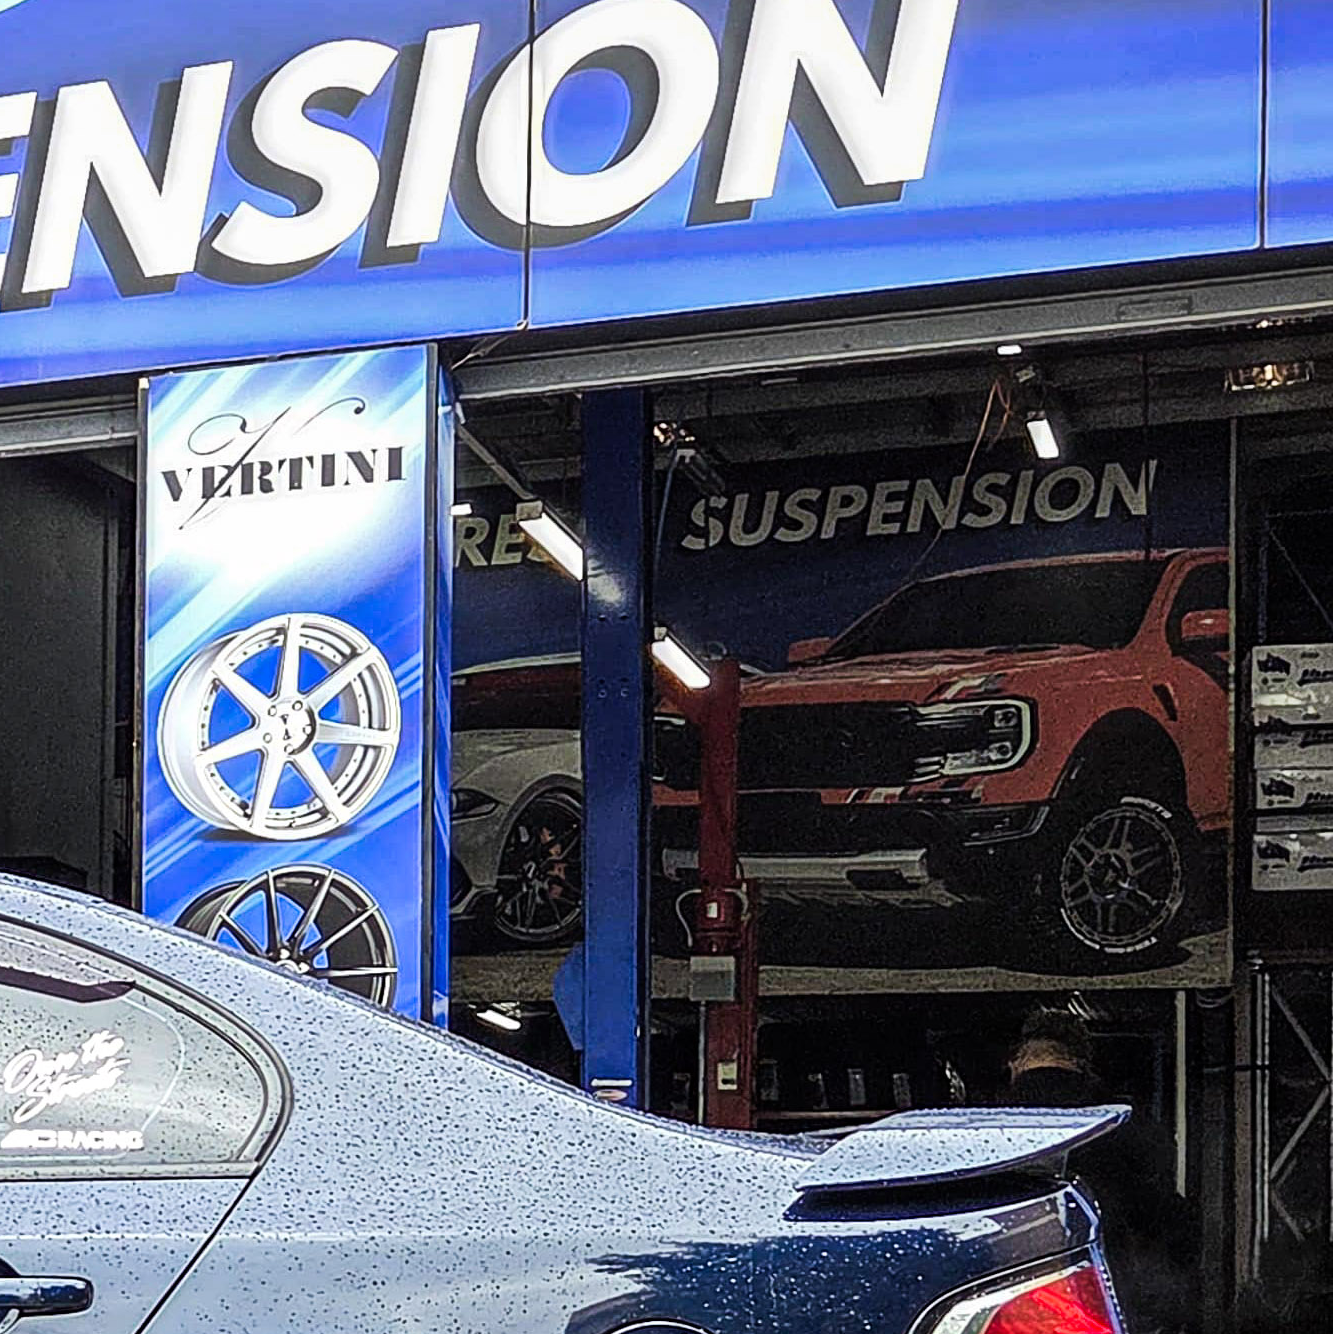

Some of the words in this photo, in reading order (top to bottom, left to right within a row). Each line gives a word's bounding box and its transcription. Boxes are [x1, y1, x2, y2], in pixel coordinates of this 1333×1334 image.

[161, 446, 408, 502] VERTINI
[680, 458, 1158, 550] SUSPENSION
[455, 513, 548, 567] RE
[58, 1129, 145, 1151] RACING
